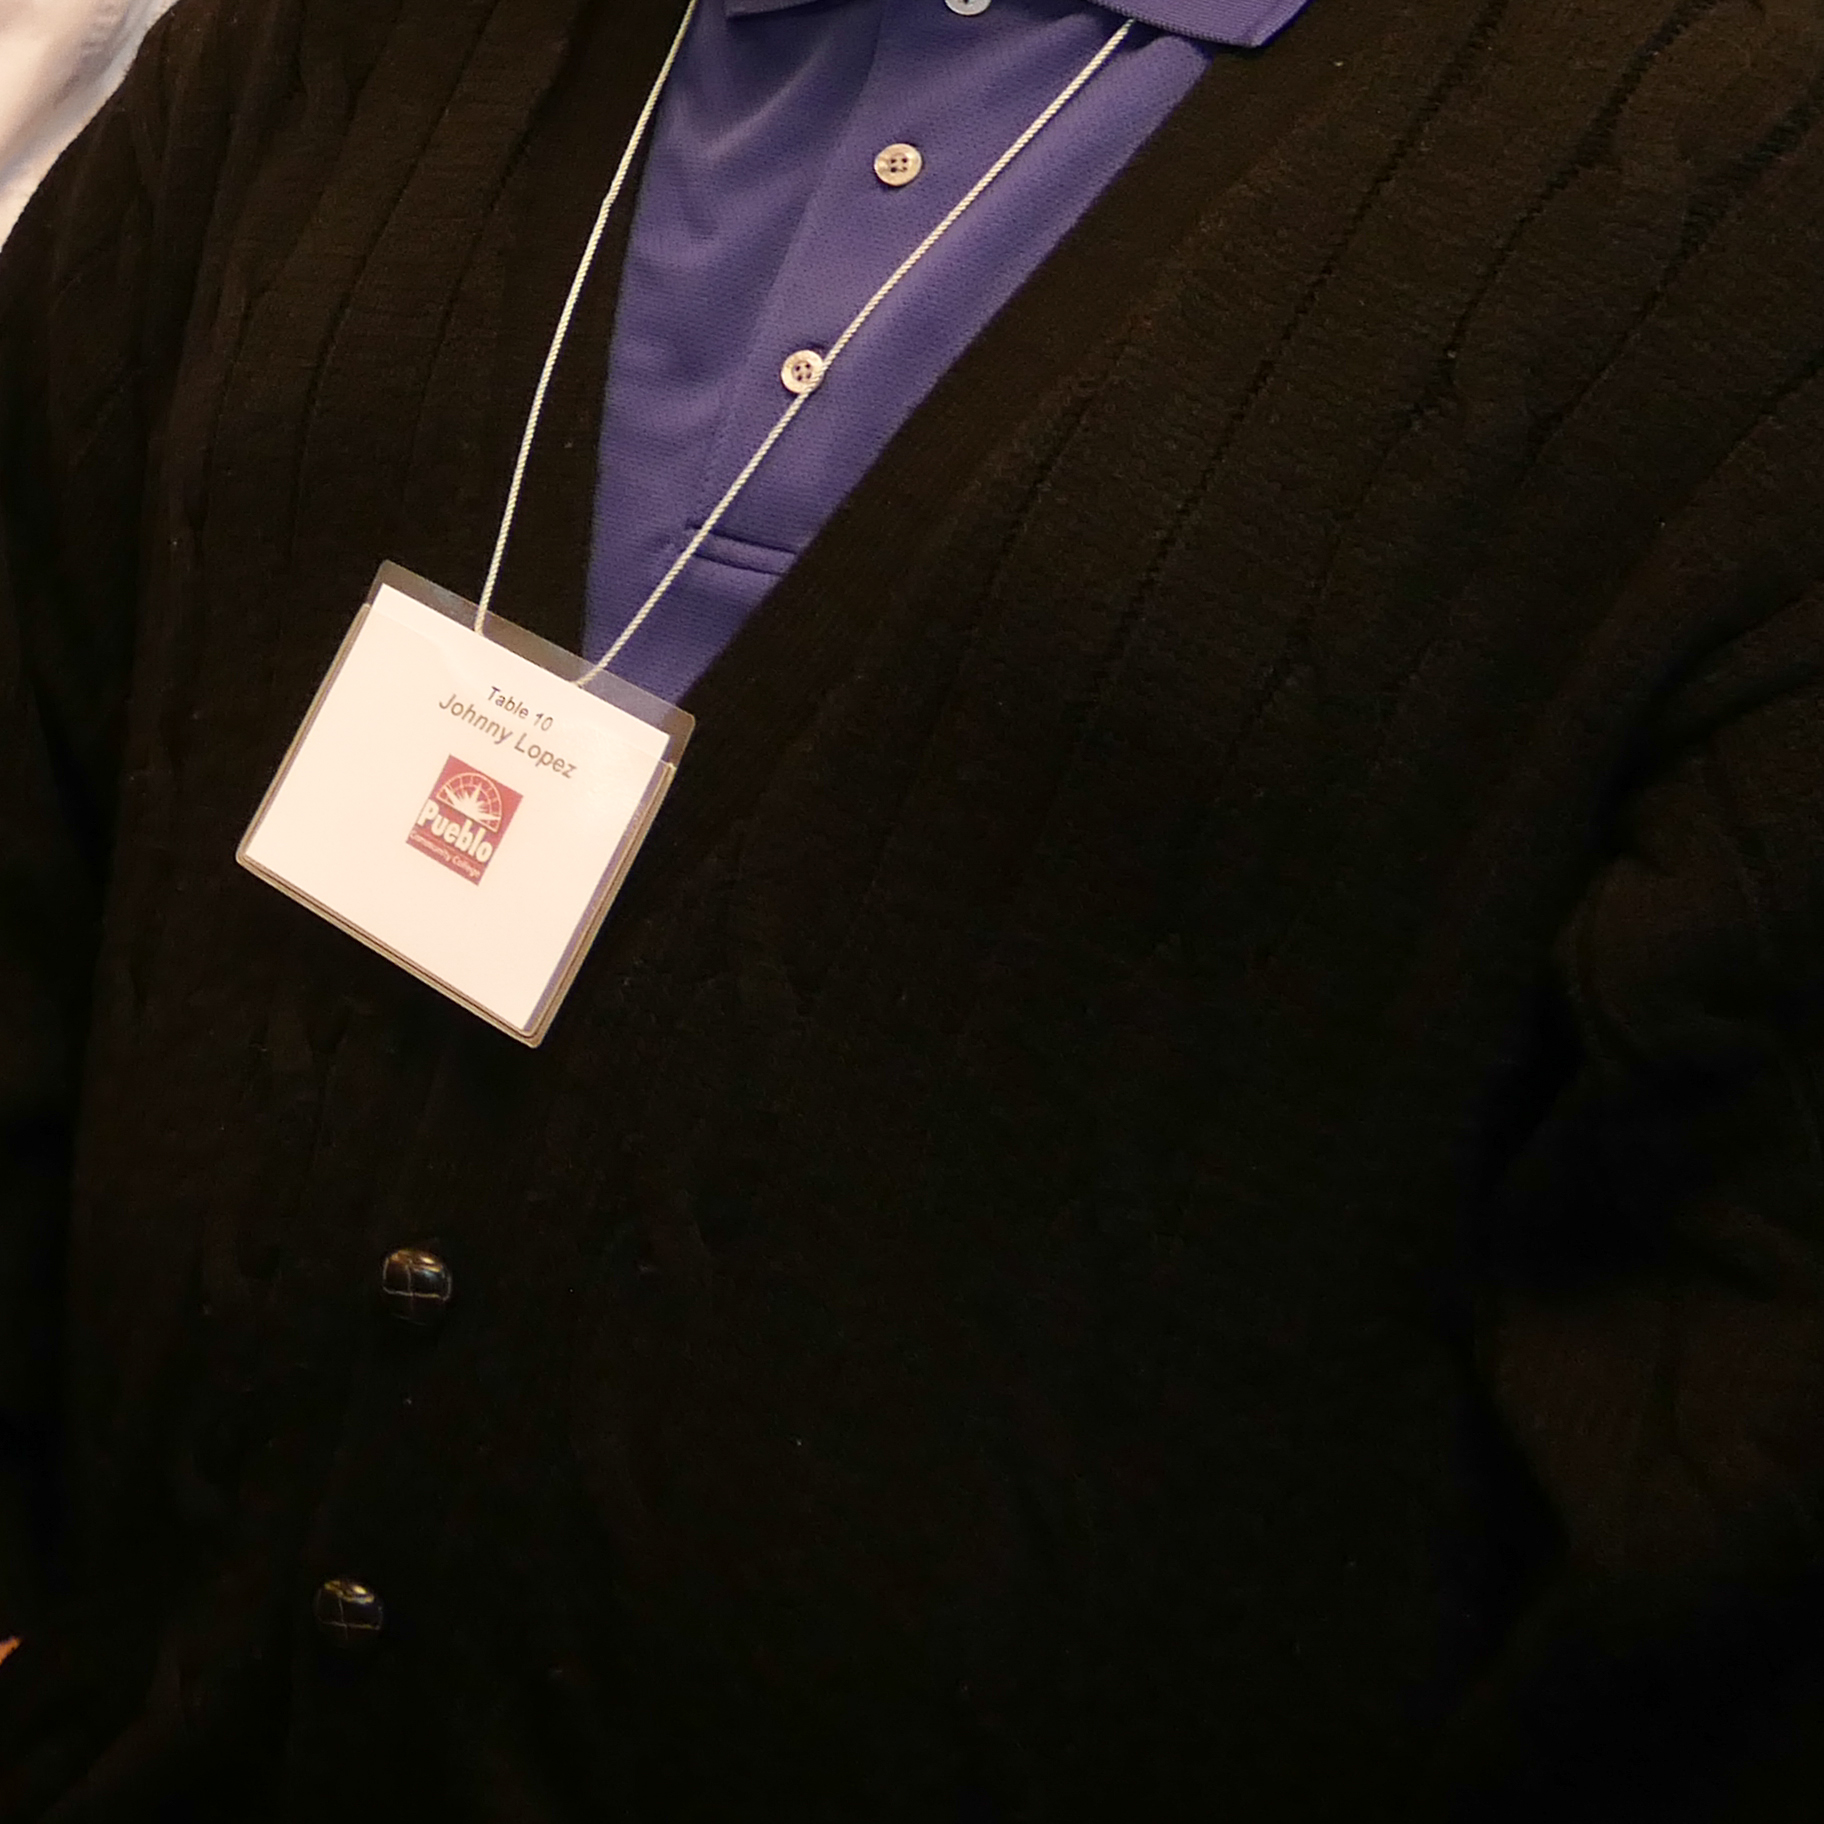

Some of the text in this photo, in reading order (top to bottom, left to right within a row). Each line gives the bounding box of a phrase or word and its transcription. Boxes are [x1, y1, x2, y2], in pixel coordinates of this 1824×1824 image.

[438, 693, 578, 779] Johnny Lopez
[487, 685, 554, 732] Table 10
[417, 799, 493, 863] Pueblo
